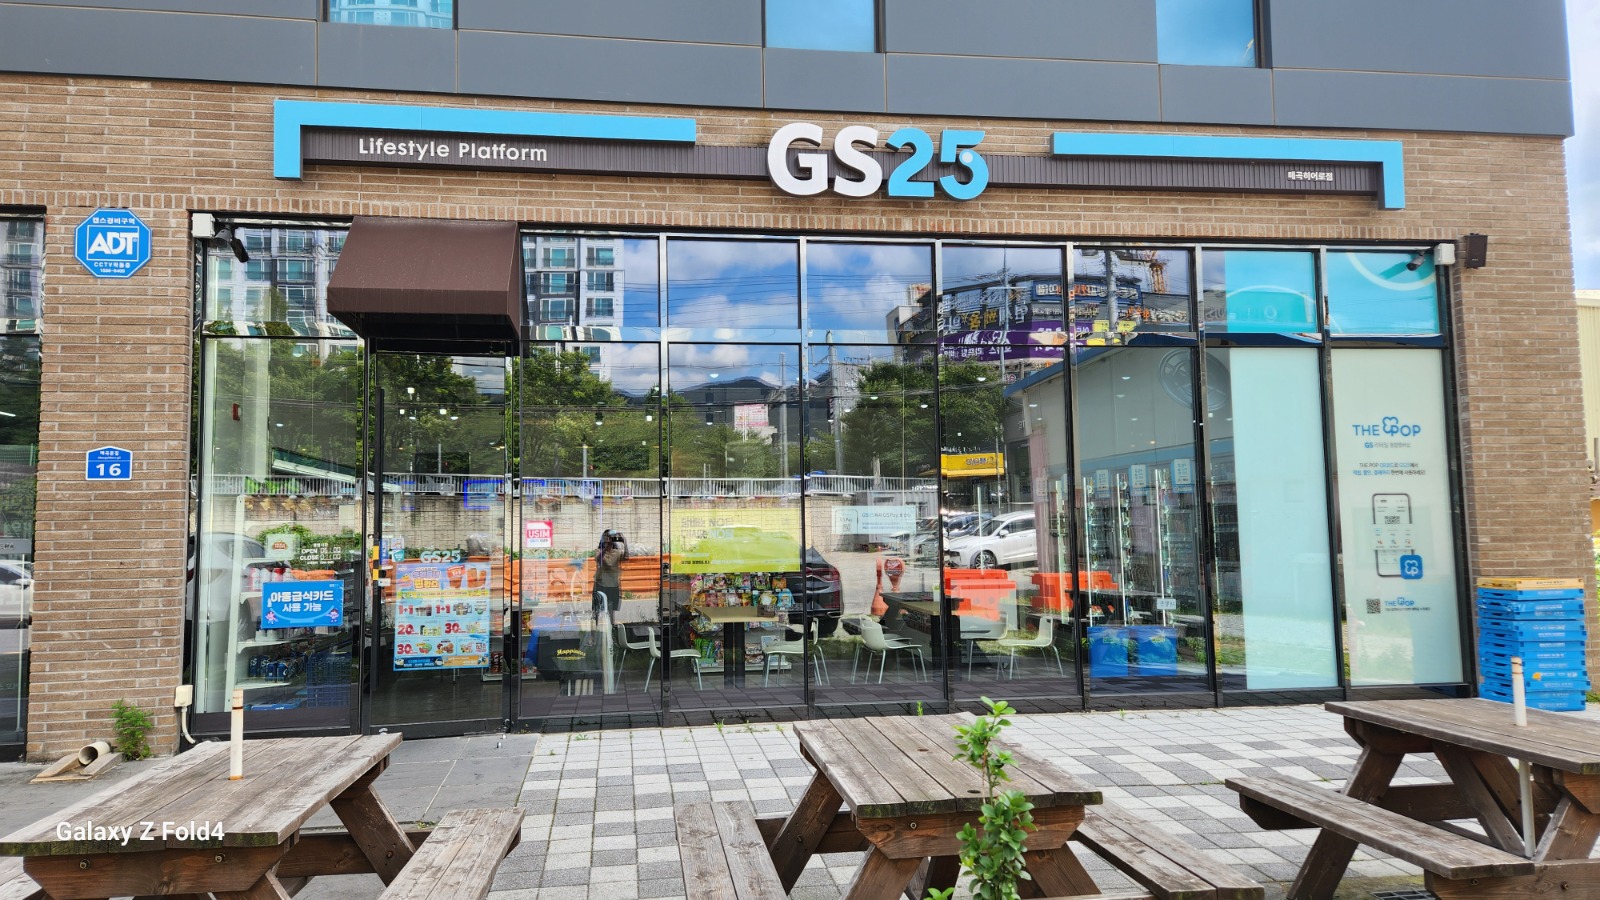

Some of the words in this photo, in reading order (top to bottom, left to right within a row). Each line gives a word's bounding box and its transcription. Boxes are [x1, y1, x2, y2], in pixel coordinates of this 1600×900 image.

[359, 138, 450, 161] Lifestyle
[459, 142, 548, 162] Platform
[767, 122, 989, 200] GS25
[1287, 170, 1333, 181] 매곡히어로점
[88, 231, 139, 255] ADT
[1352, 424, 1380, 436] THE
[1382, 416, 1421, 437] POP
[96, 463, 122, 477] 16
[528, 529, 550, 538] USIM
[420, 550, 461, 563] GS25
[270, 590, 334, 602] 아동급식카드
[282, 602, 301, 612] 사용
[303, 602, 322, 612] 가능
[435, 604, 451, 614] 1+1
